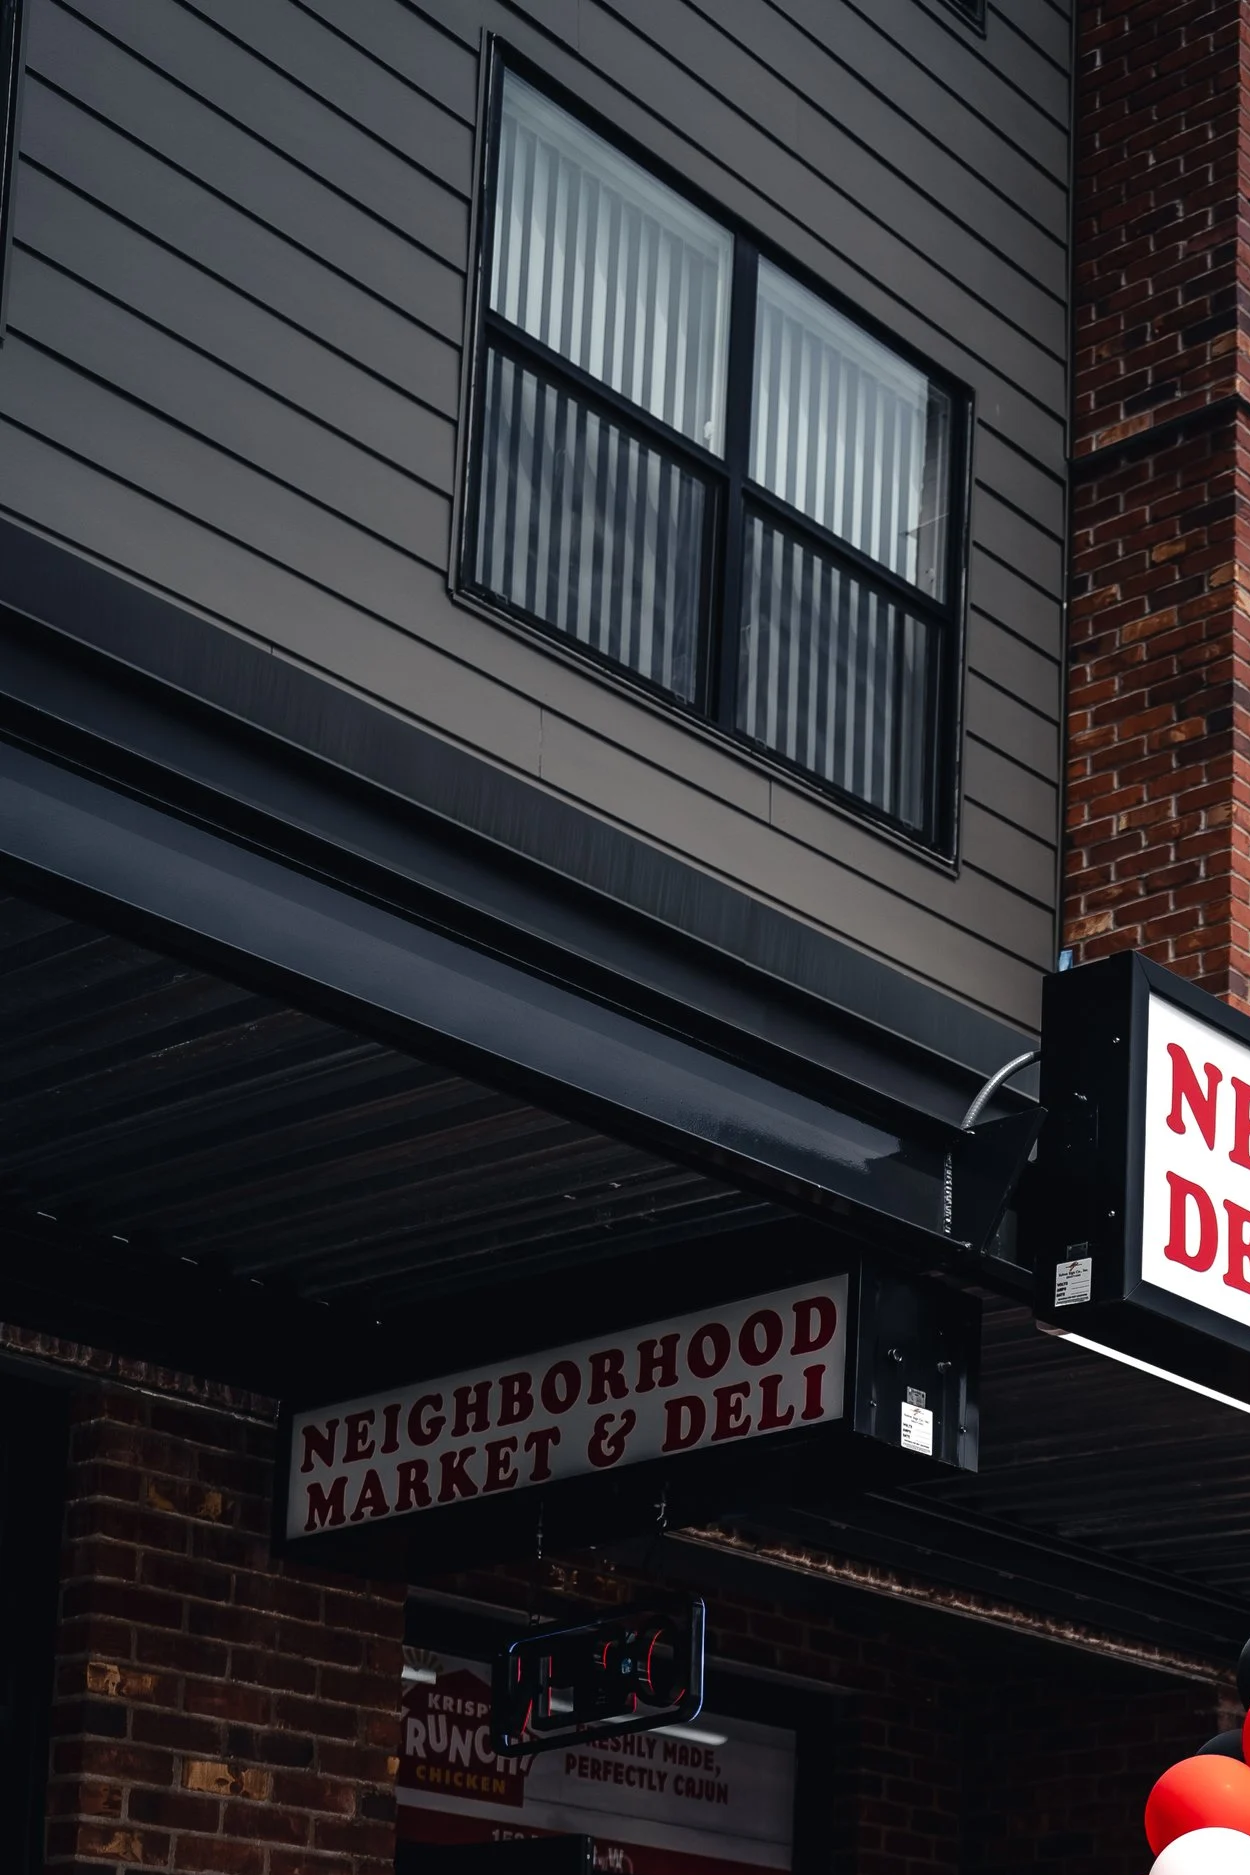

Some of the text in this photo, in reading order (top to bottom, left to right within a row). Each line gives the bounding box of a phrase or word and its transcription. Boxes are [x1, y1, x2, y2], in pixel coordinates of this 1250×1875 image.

[300, 1295, 837, 1473] NEIGHBORHOOD
[303, 1363, 826, 1533] MARKET & DELI
[428, 1692, 492, 1720] KRISP
[403, 1714, 533, 1777] RUNC
[663, 1741, 721, 1778] MADE,
[415, 1764, 506, 1796] CHICKEN
[565, 1753, 728, 1805] PERFECTLY CAJUN
